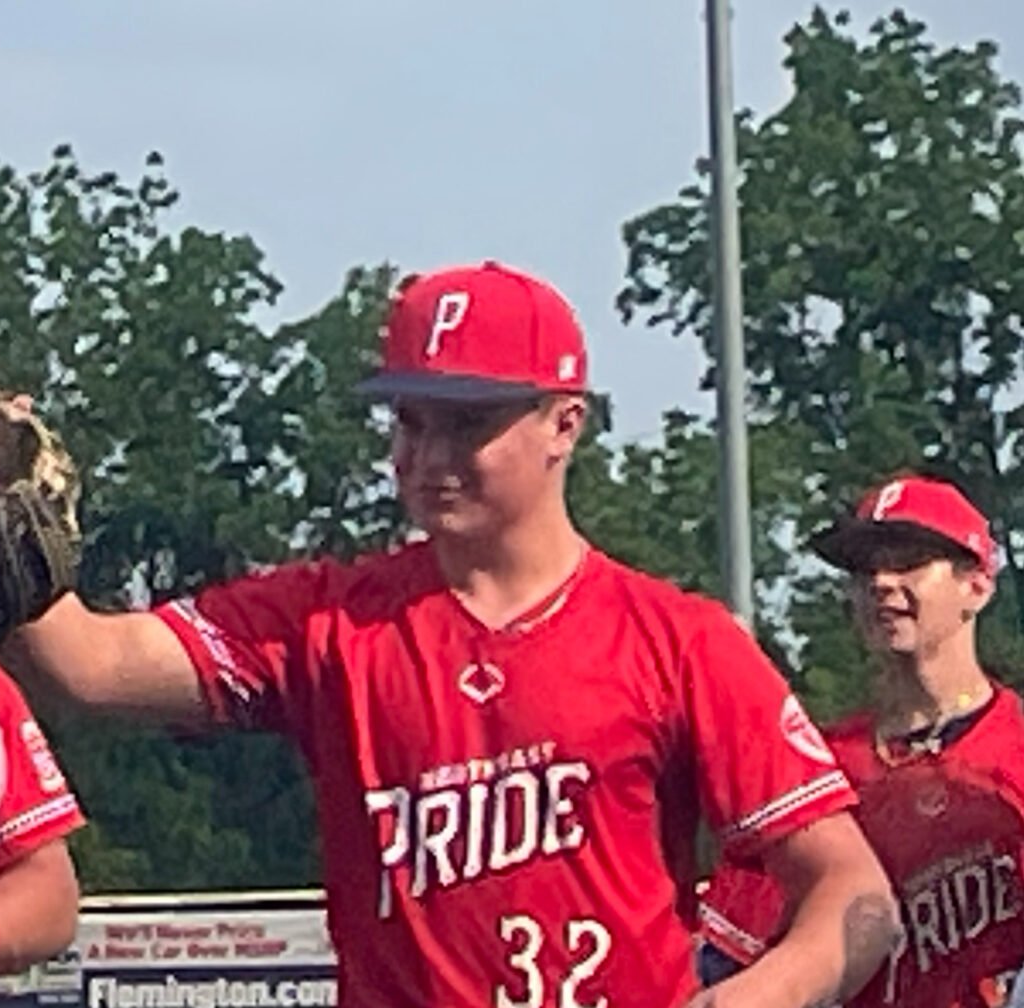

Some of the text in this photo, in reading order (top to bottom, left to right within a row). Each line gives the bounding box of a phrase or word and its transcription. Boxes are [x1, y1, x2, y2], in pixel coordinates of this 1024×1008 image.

[425, 291, 471, 357] P
[873, 480, 904, 521] P
[363, 761, 592, 920] PRIDE
[88, 944, 100, 959] A
[150, 942, 182, 959] Car
